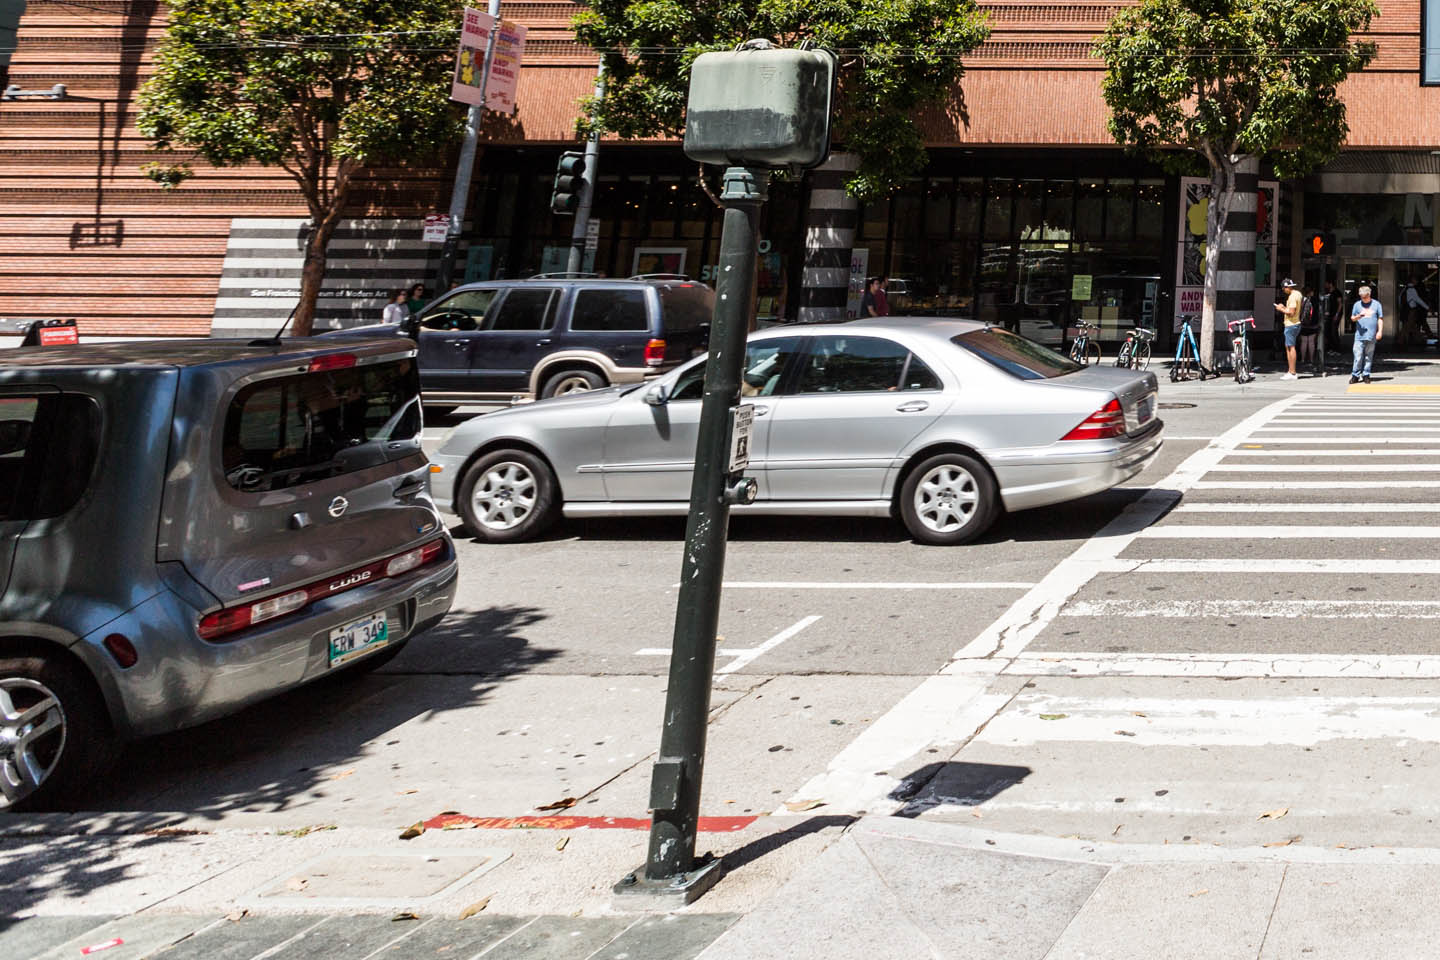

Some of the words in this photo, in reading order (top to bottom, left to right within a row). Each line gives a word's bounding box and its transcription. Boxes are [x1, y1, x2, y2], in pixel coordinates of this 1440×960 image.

[467, 13, 480, 25] SEE
[266, 289, 302, 297] Francisc
[1181, 291, 1205, 301] ANDY
[329, 570, 372, 591] cube
[363, 620, 385, 645] 349
